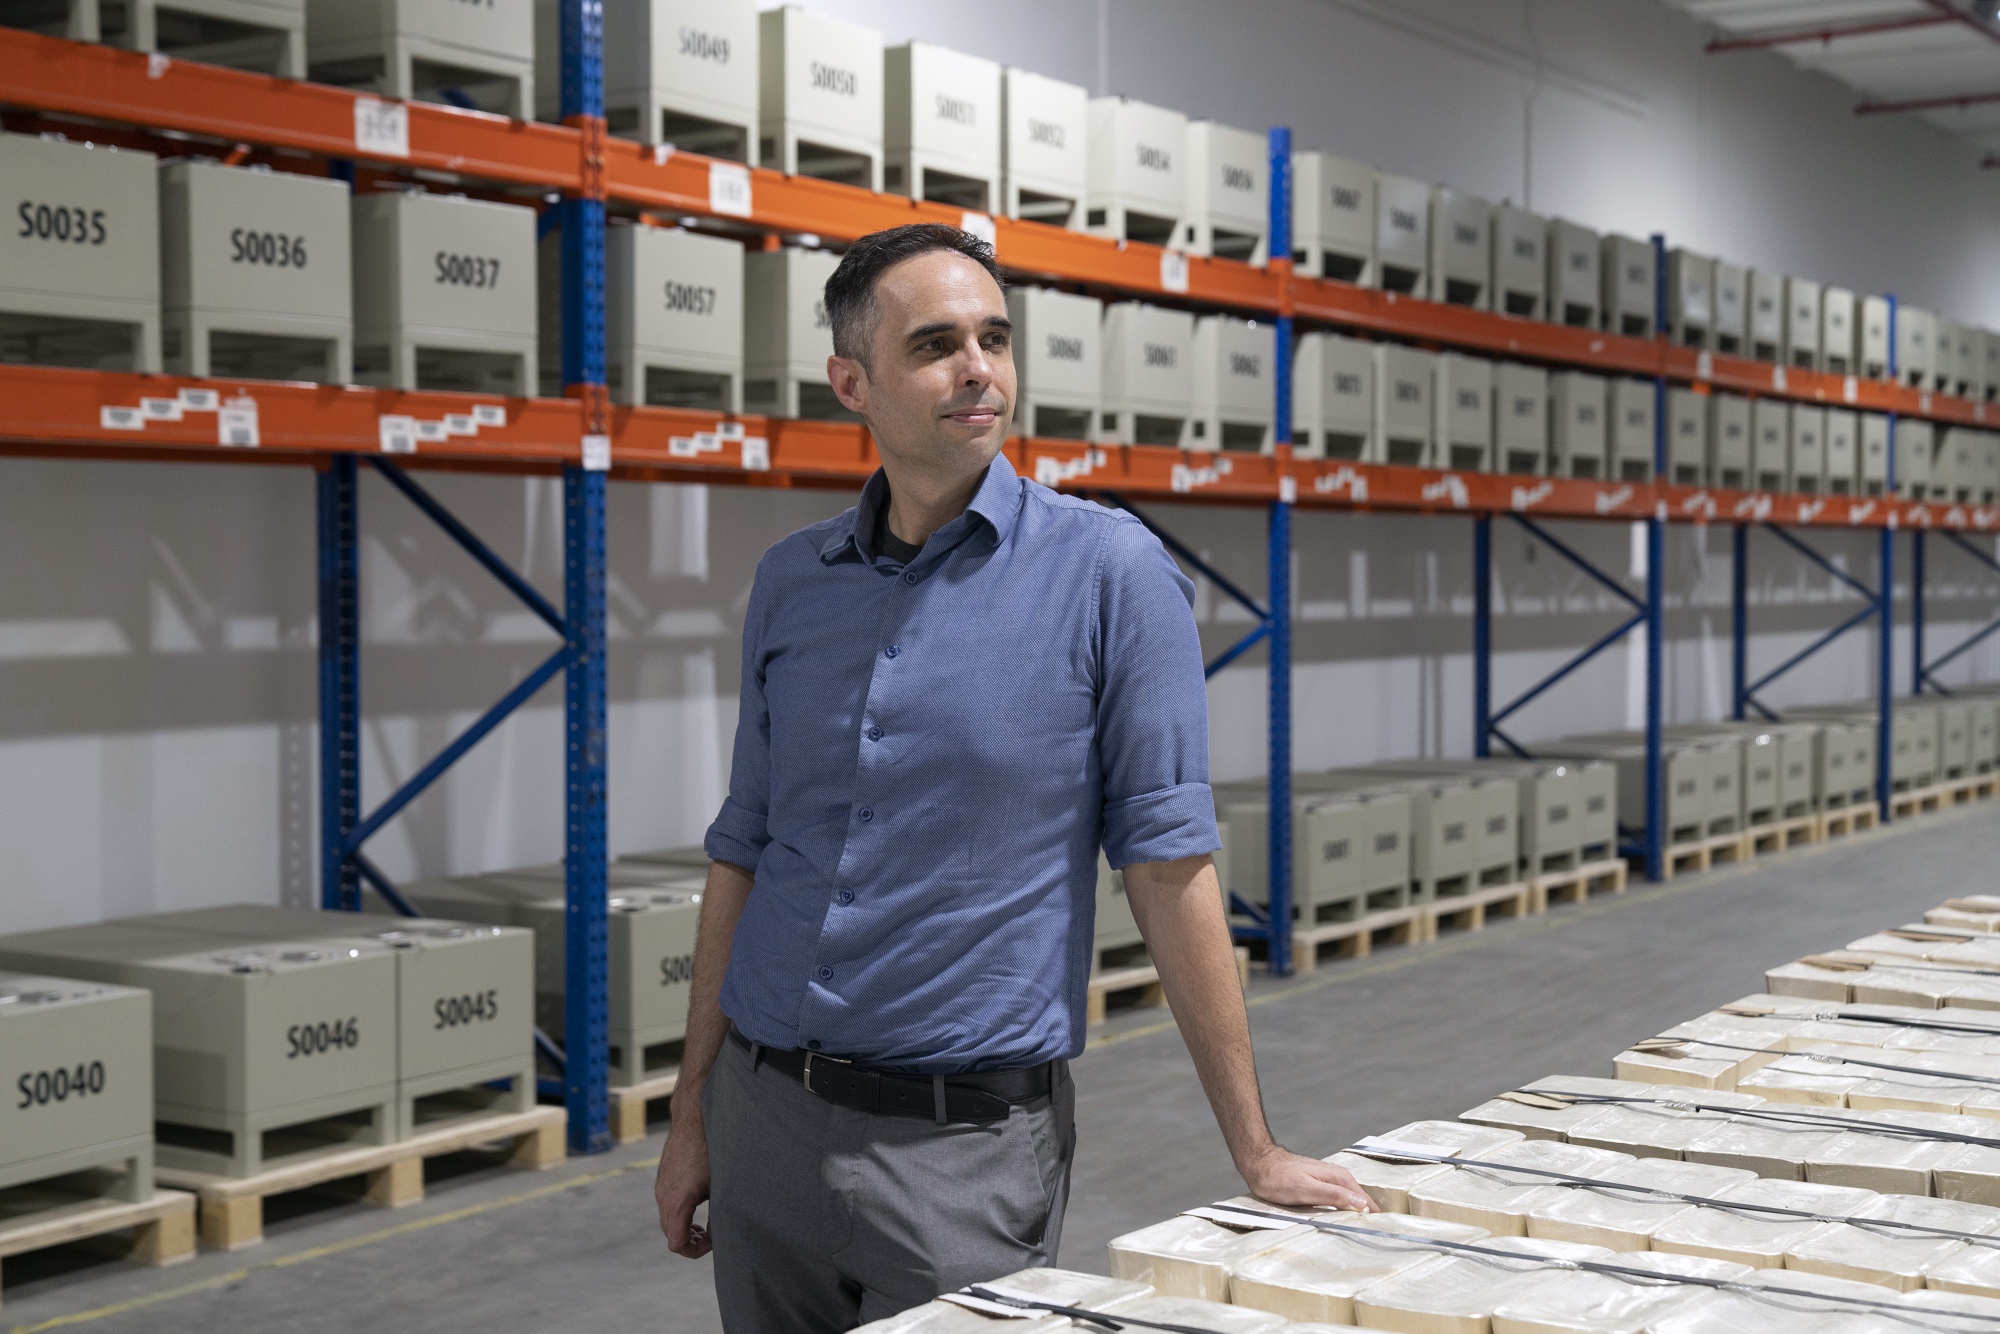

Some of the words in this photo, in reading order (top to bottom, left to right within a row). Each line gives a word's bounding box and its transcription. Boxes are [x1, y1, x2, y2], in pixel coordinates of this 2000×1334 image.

[17, 200, 107, 246] S0035
[230, 227, 308, 269] S0036
[434, 250, 501, 290] S0037
[663, 280, 716, 316] S0057
[660, 954, 693, 987] S00
[433, 989, 498, 1031] S0045
[286, 1016, 360, 1059] S0046
[17, 1060, 106, 1109] S0040
